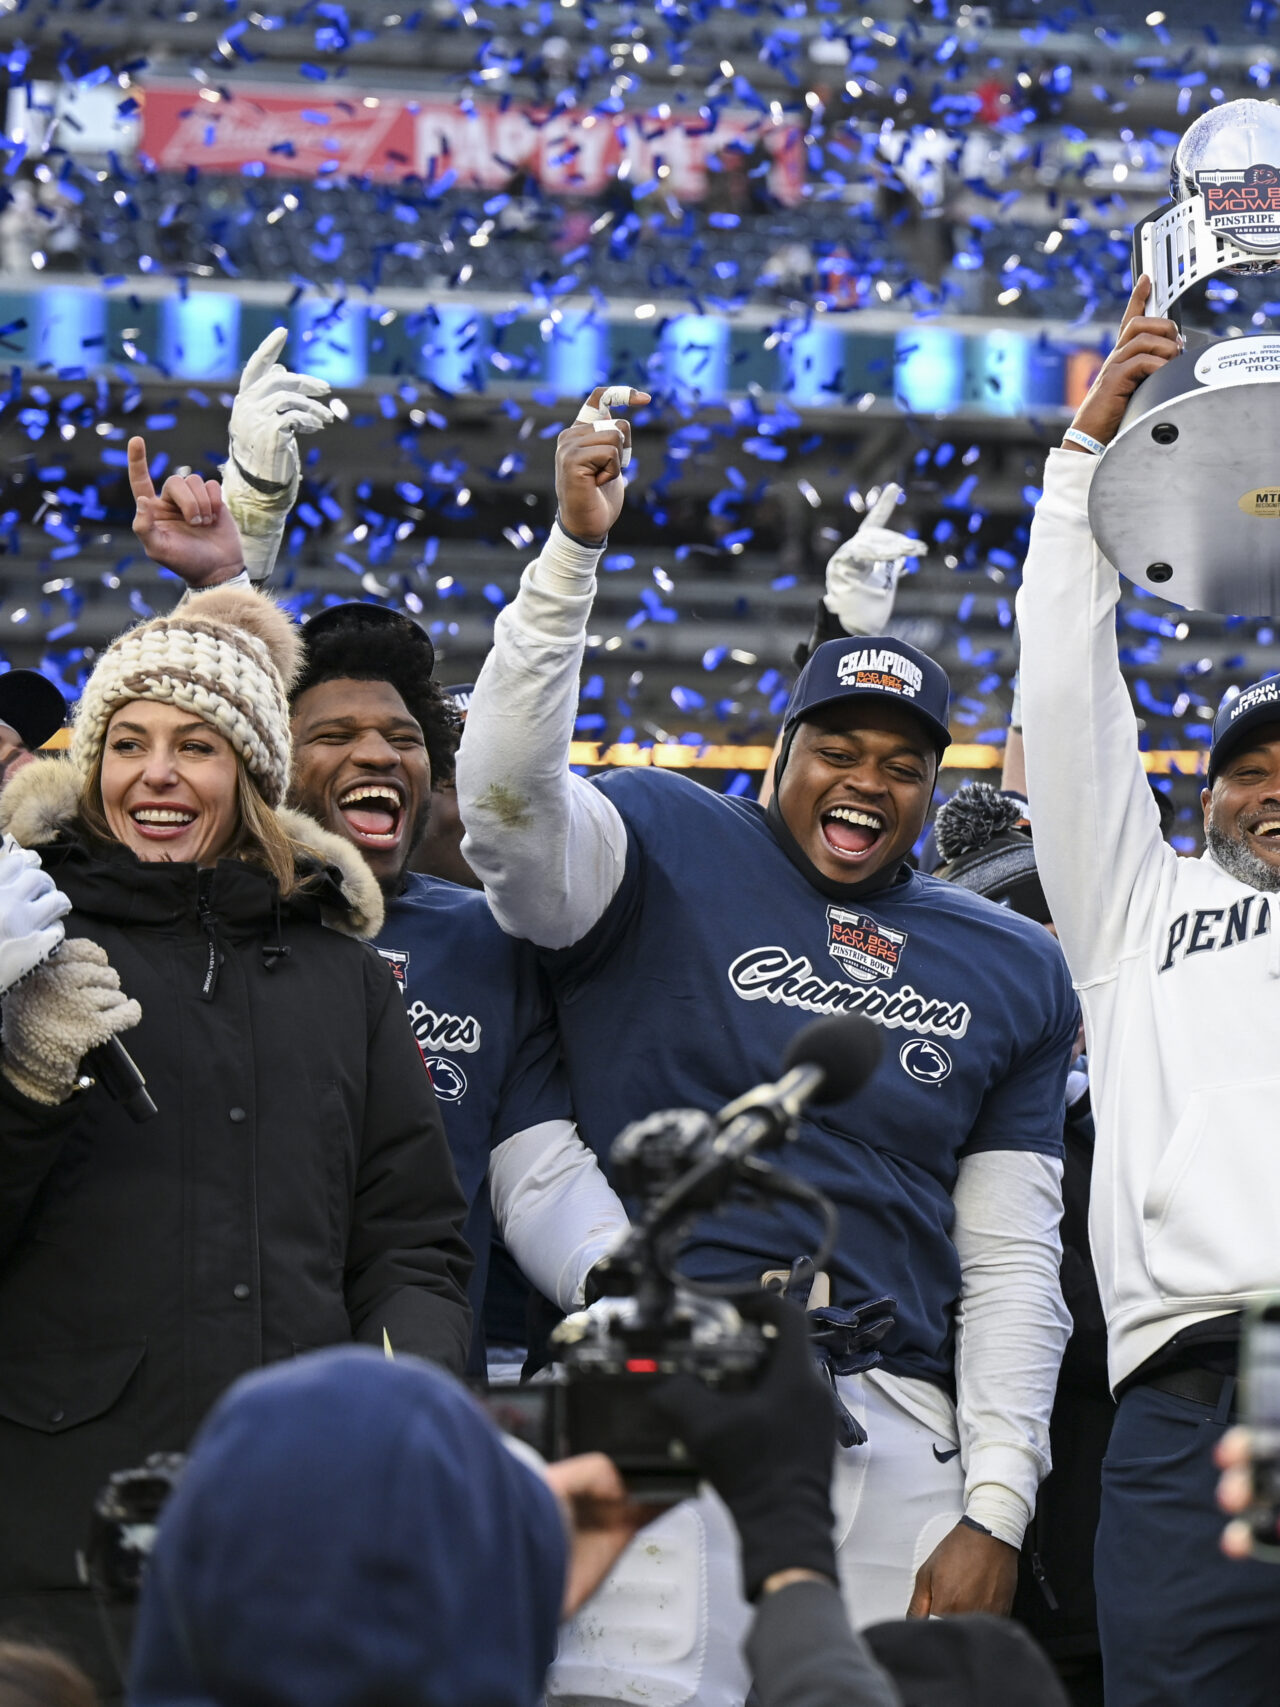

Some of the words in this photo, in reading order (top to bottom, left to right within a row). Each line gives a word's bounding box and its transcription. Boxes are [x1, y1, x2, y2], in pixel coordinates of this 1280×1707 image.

[1208, 188, 1258, 199] BAD
[1214, 213, 1275, 227] PINSTRIPE
[1218, 351, 1248, 361] GEORGE
[836, 649, 923, 692] CHAMPIONS
[857, 671, 879, 679] BAD
[881, 674, 902, 684] BOY
[840, 675, 856, 686] 20
[856, 677, 902, 690] MOWERS
[902, 684, 916, 698] 25
[1238, 682, 1276, 705] PENN
[832, 923, 864, 941] BAD
[868, 934, 898, 951] BOY
[831, 931, 898, 963] MOWERS
[832, 945, 868, 963] PINSTRIPE
[869, 959, 891, 975] BOWL
[729, 946, 971, 1040] Champions
